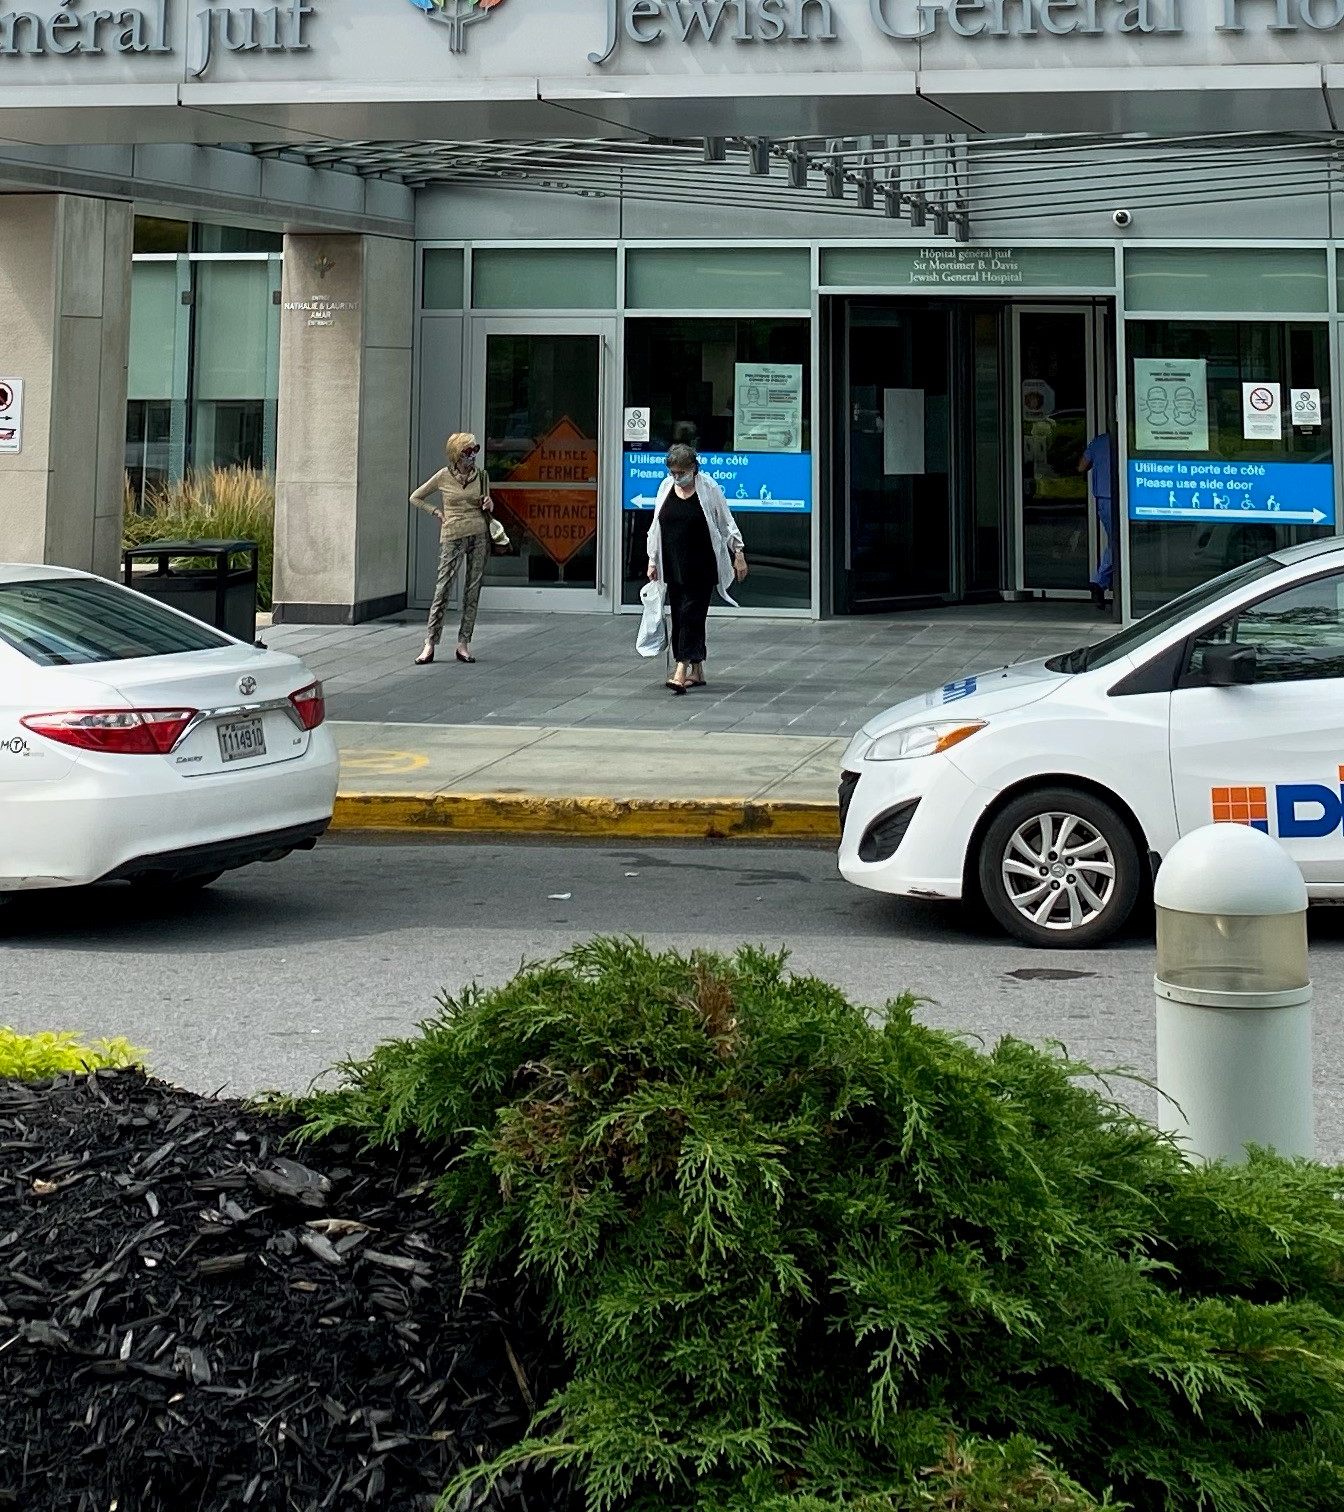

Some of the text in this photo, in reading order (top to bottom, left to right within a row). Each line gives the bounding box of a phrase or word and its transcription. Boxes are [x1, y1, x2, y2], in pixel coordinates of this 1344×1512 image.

[919, 248, 1012, 262] Hôpital général juif
[913, 259, 1018, 270] Sir Mortimer B. Davis
[908, 271, 1023, 285] Jewish General Hospital
[284, 302, 318, 310] NATHALIE
[629, 454, 667, 465] Utiliser
[710, 455, 723, 465] de
[726, 454, 749, 466] côté
[630, 468, 664, 479] Please
[712, 469, 738, 480] door
[1135, 462, 1266, 476] Utiliser la porte de côté
[1135, 477, 1254, 490] Please use side door
[528, 504, 596, 520] ENTRANCE
[537, 524, 587, 540] CLOSED
